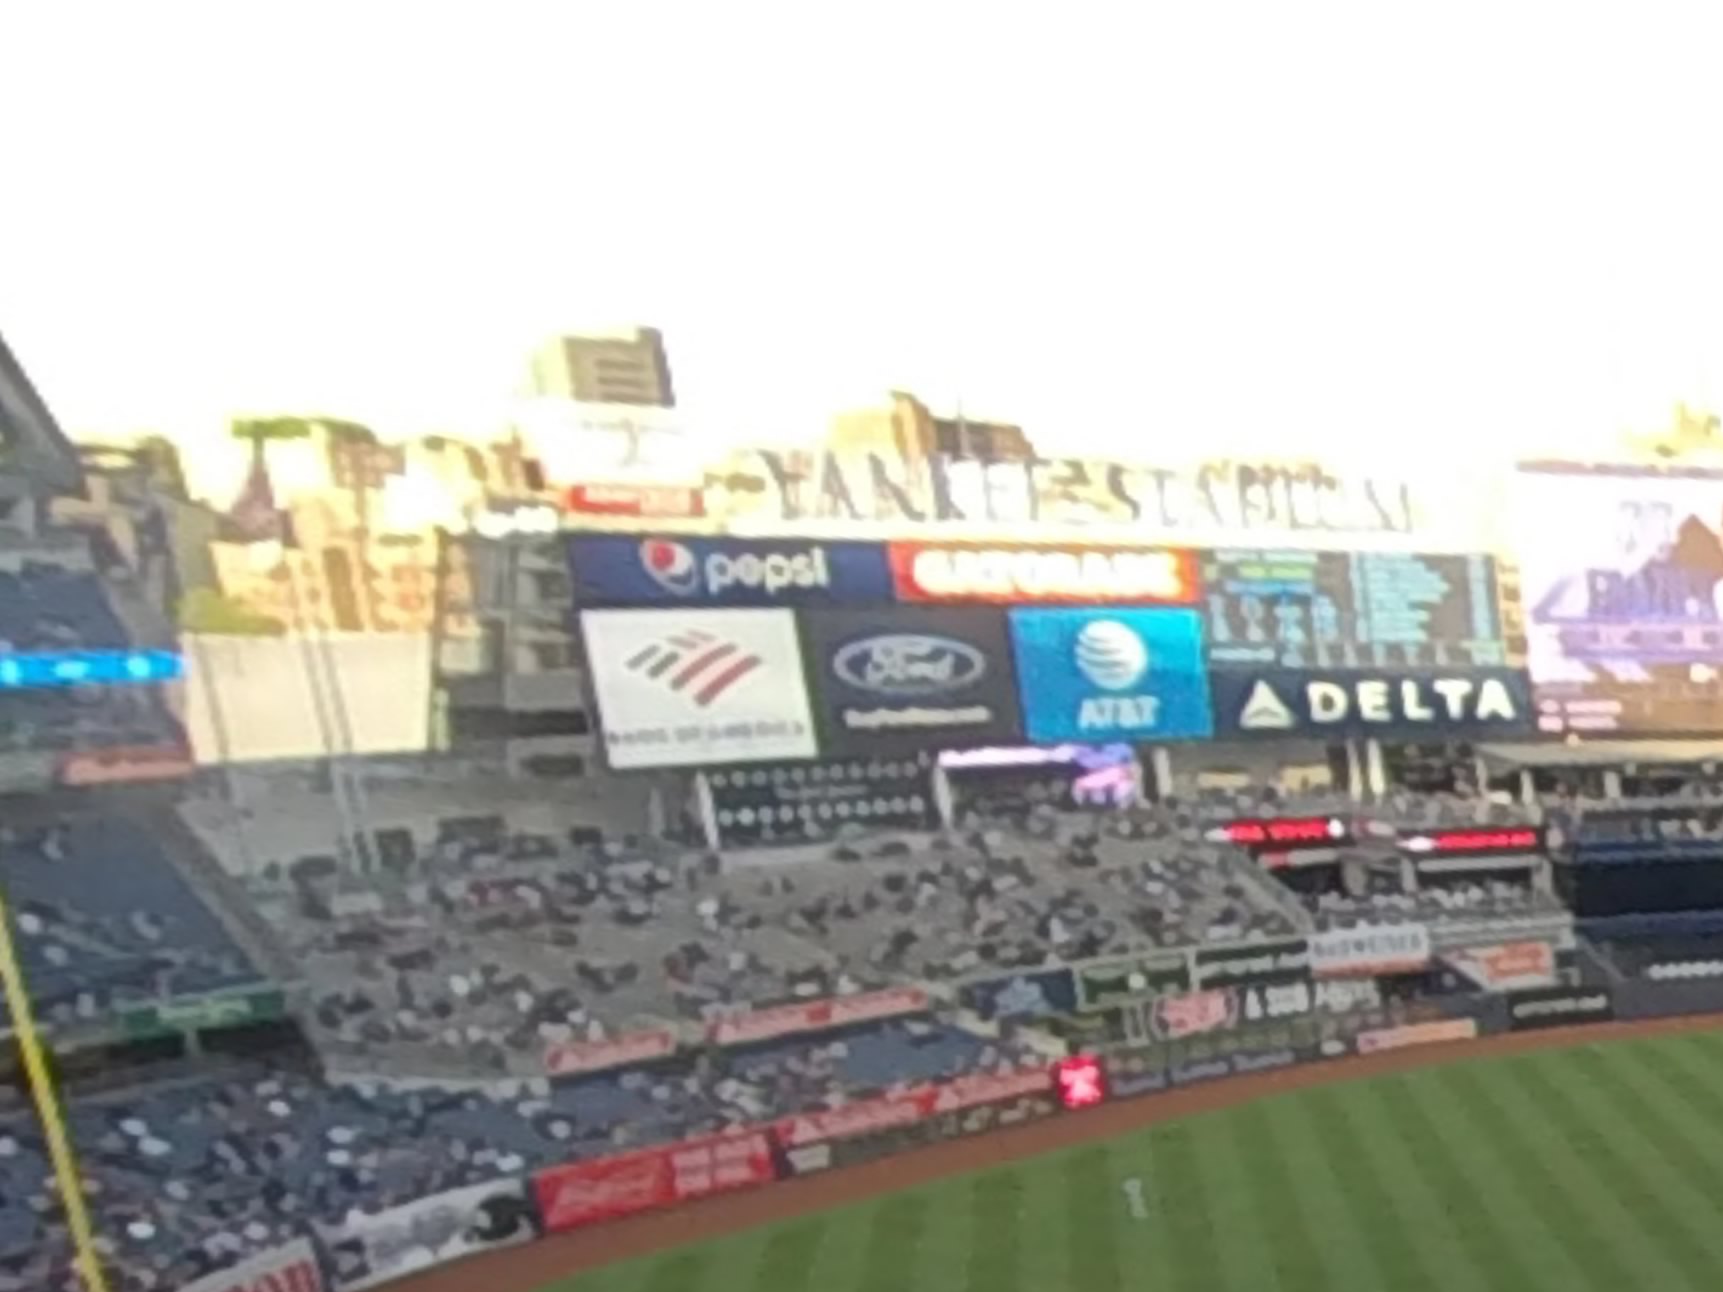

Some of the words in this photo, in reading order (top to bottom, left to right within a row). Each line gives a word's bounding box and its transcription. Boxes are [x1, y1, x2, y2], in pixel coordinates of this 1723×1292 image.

[704, 546, 831, 595] pepsi
[862, 647, 956, 682] Ford
[1078, 697, 1160, 729] AT&T
[1306, 678, 1517, 723] DELTA
